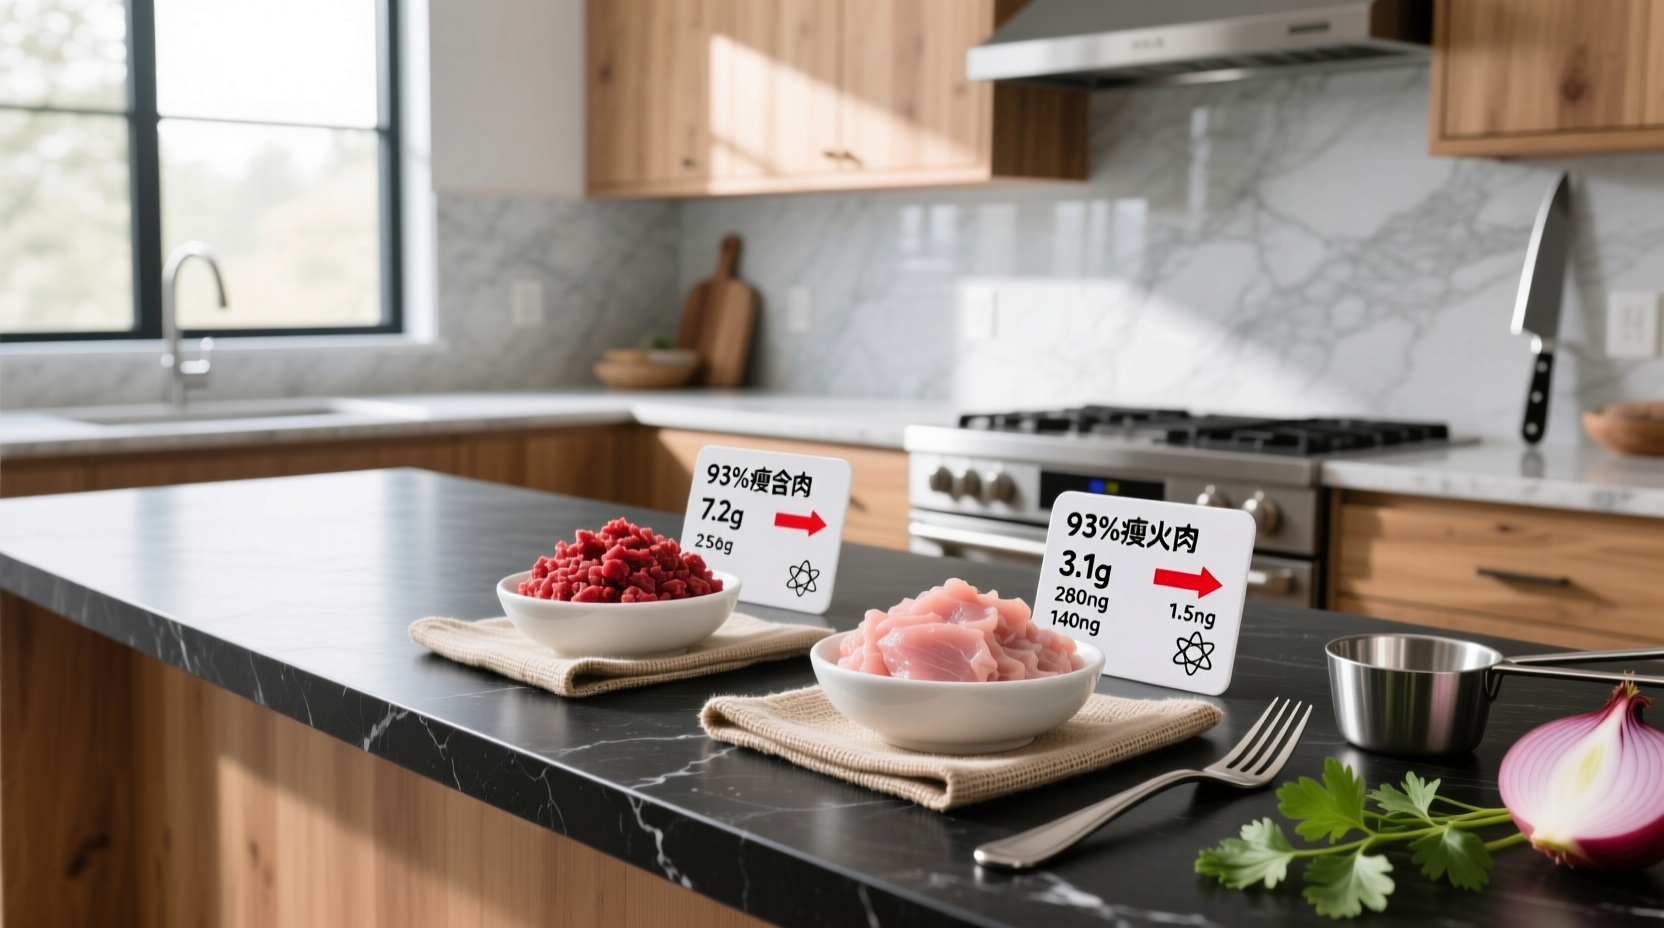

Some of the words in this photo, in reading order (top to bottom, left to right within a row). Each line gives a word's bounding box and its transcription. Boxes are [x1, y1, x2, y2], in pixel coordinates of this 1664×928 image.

[701, 497, 744, 531] 7.2g
[1066, 511, 1200, 554] 93%瘦火肉
[1058, 549, 1112, 590] 3.1g
[1054, 585, 1110, 614] 280ng
[1050, 609, 1101, 637] 140ng
[1169, 602, 1216, 630] 1.5ng
